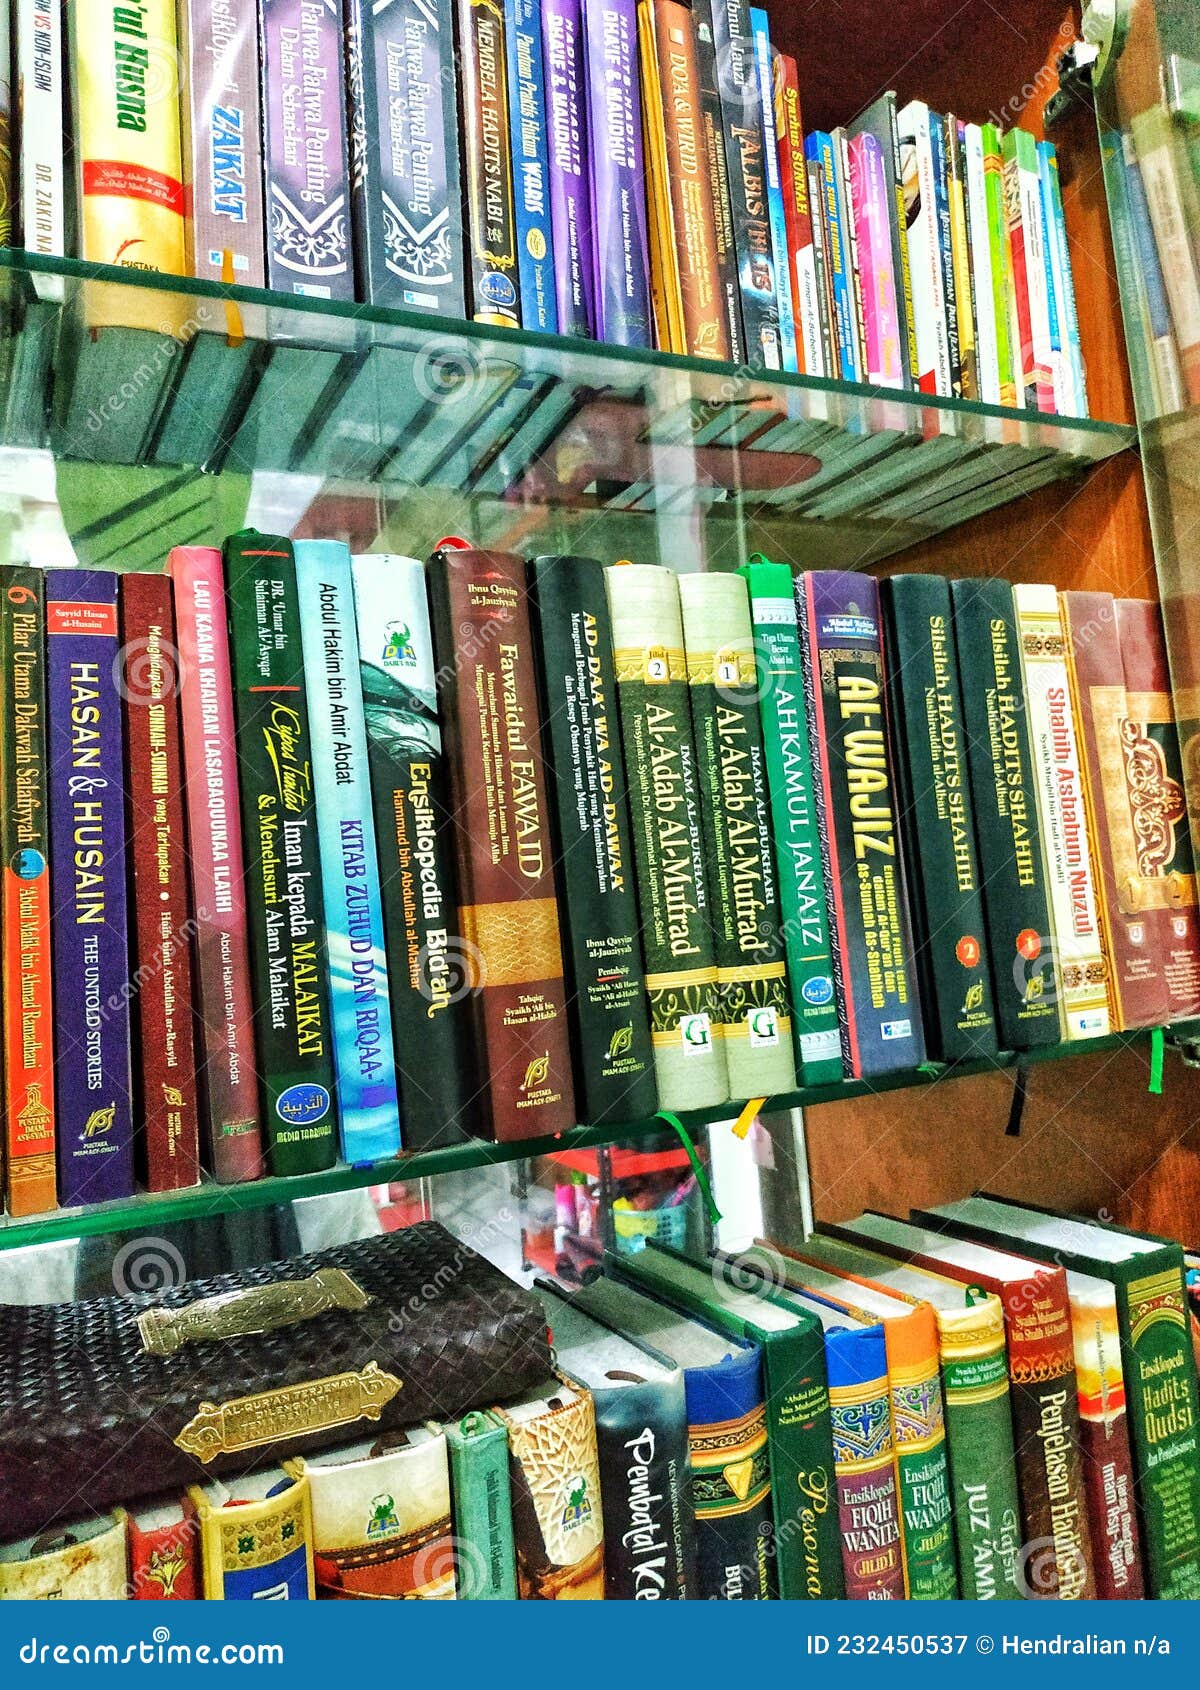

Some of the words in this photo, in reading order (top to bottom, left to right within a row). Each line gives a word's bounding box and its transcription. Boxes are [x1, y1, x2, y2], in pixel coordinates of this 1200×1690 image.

[34, 15, 51, 31] VS
[34, 29, 52, 92] NON-ISLAM
[278, 27, 296, 79] Dalam
[301, 2, 327, 123] Fatwa-Fatwa
[386, 40, 401, 94] Dalam
[405, 17, 428, 135] Fatwa-Fatwa
[477, 18, 495, 103] MEMBELA
[515, 31, 534, 81] Panduan
[551, 74, 565, 86] &
[604, 70, 619, 83] &
[113, 41, 148, 133] Husna
[518, 81, 537, 118] Praktis
[565, 19, 580, 176] HADITS-HADITS
[618, 15, 636, 170] HADITS-HADITS
[674, 97, 690, 111] &
[280, 81, 302, 167] Sehari-hari
[388, 96, 409, 178] Sehari-hari
[480, 106, 500, 175] HADITS
[521, 120, 538, 158] Hukum
[551, 92, 572, 174] MAUDHU'
[604, 88, 626, 167] MAUDHU'
[785, 87, 800, 146] Syarhus
[211, 105, 248, 222] ZAKAT
[301, 124, 330, 205] Penting
[678, 114, 697, 174] WIRID
[730, 123, 767, 215] TALBIS
[35, 164, 52, 185] DR.
[408, 136, 432, 215] Penting
[524, 161, 545, 216] WARIS
[620, 189, 629, 212] Abdul
[791, 151, 807, 215] SUNNAH
[35, 188, 53, 229] ZAKIR
[485, 178, 503, 226] NABI
[567, 196, 576, 219] Abdul
[621, 213, 630, 238] Hakim
[567, 220, 578, 246] Hakim
[940, 210, 951, 250] MISTERI
[572, 281, 581, 306] Abdat
[624, 273, 634, 297] Abdat
[942, 251, 954, 301] KEMATIAN
[946, 303, 958, 329] PARA
[938, 353, 946, 378] Abdul
[949, 332, 960, 368] ULAMA
[8, 586, 37, 603] 6
[192, 580, 210, 609] LAU
[255, 580, 269, 623] Sulaiman
[271, 580, 284, 599] DR.
[319, 582, 340, 625] Abdul
[12, 613, 36, 648] Pilar
[195, 613, 213, 663] KAANA
[275, 634, 288, 649] bin
[322, 628, 345, 674] Hakim
[930, 615, 950, 688] Silsilah
[990, 619, 1011, 690] Silsilah
[13, 652, 38, 699] Utama
[148, 625, 164, 701] Menghidupkan
[327, 676, 343, 699] bin
[564, 675, 574, 693] dan
[653, 663, 662, 676] 2
[723, 666, 731, 680] 1
[70, 663, 101, 767] HASAN
[199, 668, 218, 735] KHAIRAN
[330, 705, 350, 739] Amir
[499, 643, 527, 752] Fawaidul
[566, 695, 576, 723] Resep
[575, 660, 588, 700] Berbagai
[582, 727, 595, 769] Penyakit
[925, 687, 942, 761] Nashiruddin
[14, 703, 39, 764] Dakwah
[148, 704, 167, 794] SUNNAH-SUNNAH
[569, 724, 581, 765] Obatnya
[593, 717, 610, 752] WA
[935, 694, 960, 788] HADITS
[998, 695, 1022, 787] HADITS
[1047, 687, 1070, 763] Shahih
[334, 742, 355, 786] Abdat
[573, 767, 582, 790] yang
[646, 703, 683, 812] Al-Adab
[680, 744, 693, 793] IMAM
[716, 706, 753, 812] Al-Adab
[750, 746, 762, 793] IMAM
[775, 687, 811, 833] AHKAMUL
[837, 676, 896, 859] AL-WAJIZ
[16, 766, 39, 844] Salafiyyah
[67, 775, 107, 796] &
[204, 739, 228, 862] LASABAQUUNAA
[575, 792, 589, 831] Mujarab
[931, 763, 949, 820] al-Albani
[992, 761, 1010, 817] al-Albani
[283, 820, 305, 867] Iman
[409, 762, 443, 919] Ensiklopedia
[510, 759, 543, 879] FAWAID
[643, 810, 656, 865] Muhammad
[712, 809, 724, 863] Muhammad
[948, 790, 974, 893] SHAHIH
[1008, 789, 1035, 887] SHAHIH
[1057, 767, 1084, 866] Asbabun
[73, 802, 105, 924] HUSAIN
[154, 825, 170, 884] Terlupakan
[259, 813, 282, 904] Menelusuri
[339, 820, 367, 879] KITAB
[686, 798, 706, 909] AL-BUKHARI
[755, 797, 775, 905] AL-BUKHARI
[214, 864, 232, 913] ILAIHI
[287, 871, 315, 938] kepada
[401, 871, 416, 927] Abdullah
[657, 817, 700, 956] Al-Mufrad
[726, 816, 769, 952] Al-Mufrad
[785, 841, 822, 947] JANA'IZ
[857, 863, 874, 928] As-Sunnah
[1068, 870, 1094, 937] Nuzul
[266, 908, 286, 953] Alam
[346, 883, 375, 954] ZUHUD
[84, 935, 99, 964] THE
[220, 932, 232, 963] Abdul
[425, 927, 453, 1018] Bid'ah
[964, 942, 975, 959] 2
[85, 966, 100, 1028] UNTOLD
[223, 967, 234, 1002] Hakim
[269, 956, 289, 1029] Malaikat
[291, 941, 323, 1057] MALAIKAT
[352, 958, 377, 1003] DAN
[225, 1003, 235, 1020] bin
[227, 1023, 237, 1048] Amir
[86, 1030, 102, 1090] STORIES
[229, 1052, 240, 1085] Abdat
[1139, 1350, 1185, 1381] Ensiklopedi
[1143, 1378, 1189, 1412] Hadits
[1036, 1389, 1073, 1498] Penjelasan
[1146, 1404, 1194, 1444] Qudsi
[622, 1427, 668, 1554] Pembatal
[843, 1478, 895, 1505] Ensiklopedi
[904, 1454, 947, 1484] Ensiklopedi
[912, 1477, 946, 1507] FIQIH
[1102, 1463, 1116, 1504] Imam
[797, 1466, 829, 1599] Pesona
[852, 1505, 892, 1529] FIQIH
[905, 1497, 952, 1530] WANITA
[963, 1483, 990, 1533] JUZ
[842, 1523, 900, 1553] WANITA
